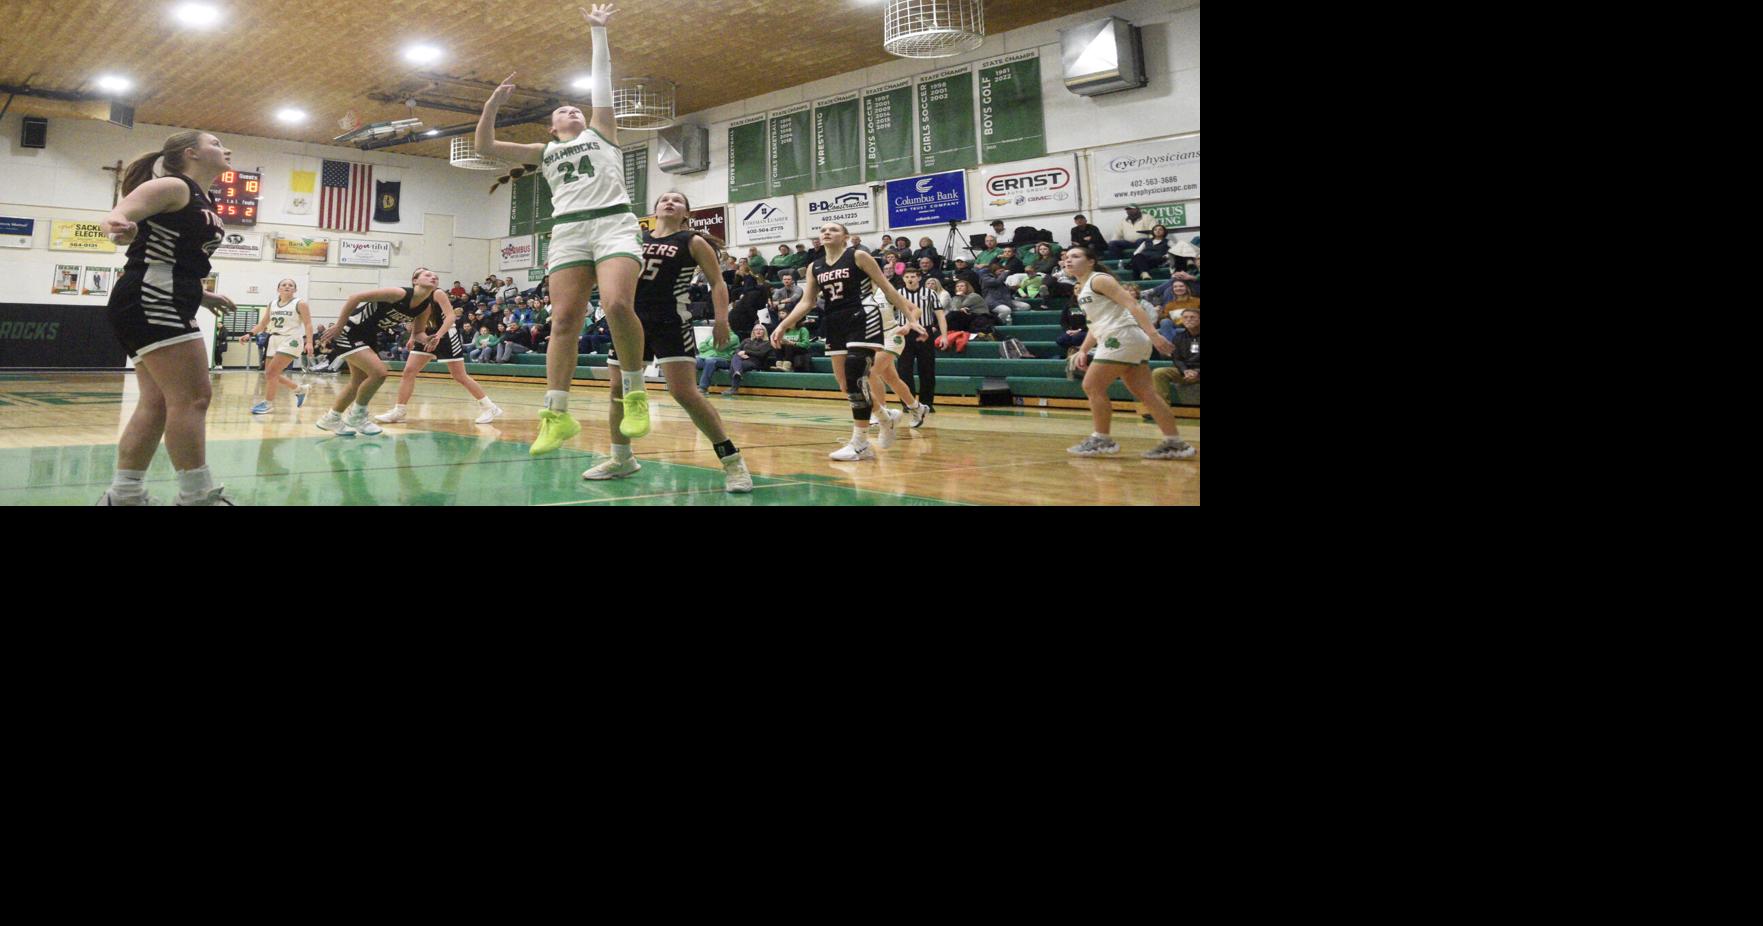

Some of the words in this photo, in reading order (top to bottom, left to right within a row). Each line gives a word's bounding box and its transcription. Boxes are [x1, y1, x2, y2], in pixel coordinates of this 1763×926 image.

[982, 59, 1002, 67] STATE
[982, 77, 992, 104] GOLF
[920, 84, 930, 122] SOCCER
[983, 107, 993, 135] BOYS
[817, 112, 825, 166] WRESTLING
[868, 136, 876, 159] BOYS
[923, 125, 931, 153] GIRLS
[543, 141, 601, 167] SHAMROCKS
[1115, 160, 1137, 170] eye
[1138, 150, 1200, 168] physicians
[222, 171, 234, 183] 18
[557, 154, 595, 184] 24
[245, 181, 258, 193] 18
[992, 172, 1062, 191] ERNST
[1114, 183, 1198, 198] www.eyephysicianspc.com
[227, 188, 234, 197] 3
[895, 193, 935, 206] Columbus
[937, 189, 959, 201] Bank
[228, 206, 235, 215] 5
[245, 207, 253, 216] 2
[689, 213, 724, 228] Pinnacle
[642, 243, 678, 258] GERS
[817, 267, 850, 284] TIGERS
[824, 281, 843, 301] 32
[0, 320, 59, 340] ROCKS
[271, 316, 285, 328] 22
